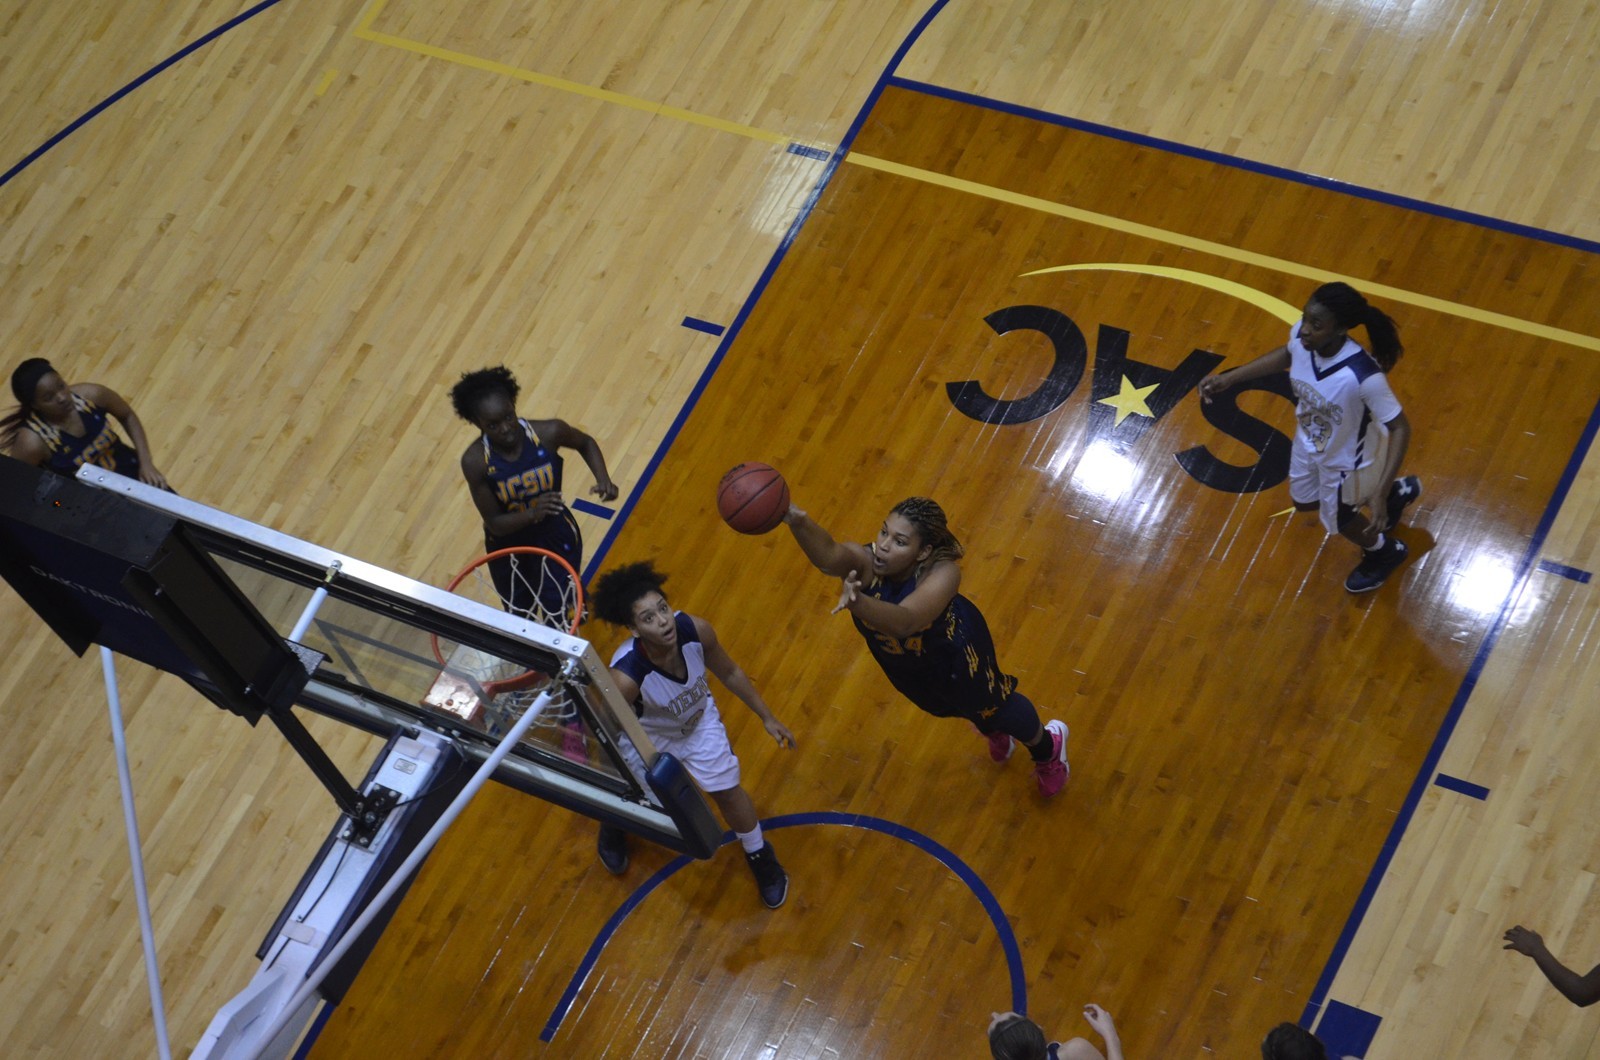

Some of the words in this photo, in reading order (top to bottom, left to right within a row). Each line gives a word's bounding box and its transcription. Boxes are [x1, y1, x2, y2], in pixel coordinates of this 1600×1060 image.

[945, 304, 1299, 493] SAC
[29, 565, 154, 619] DAKTRONI
[874, 633, 924, 657] 34
